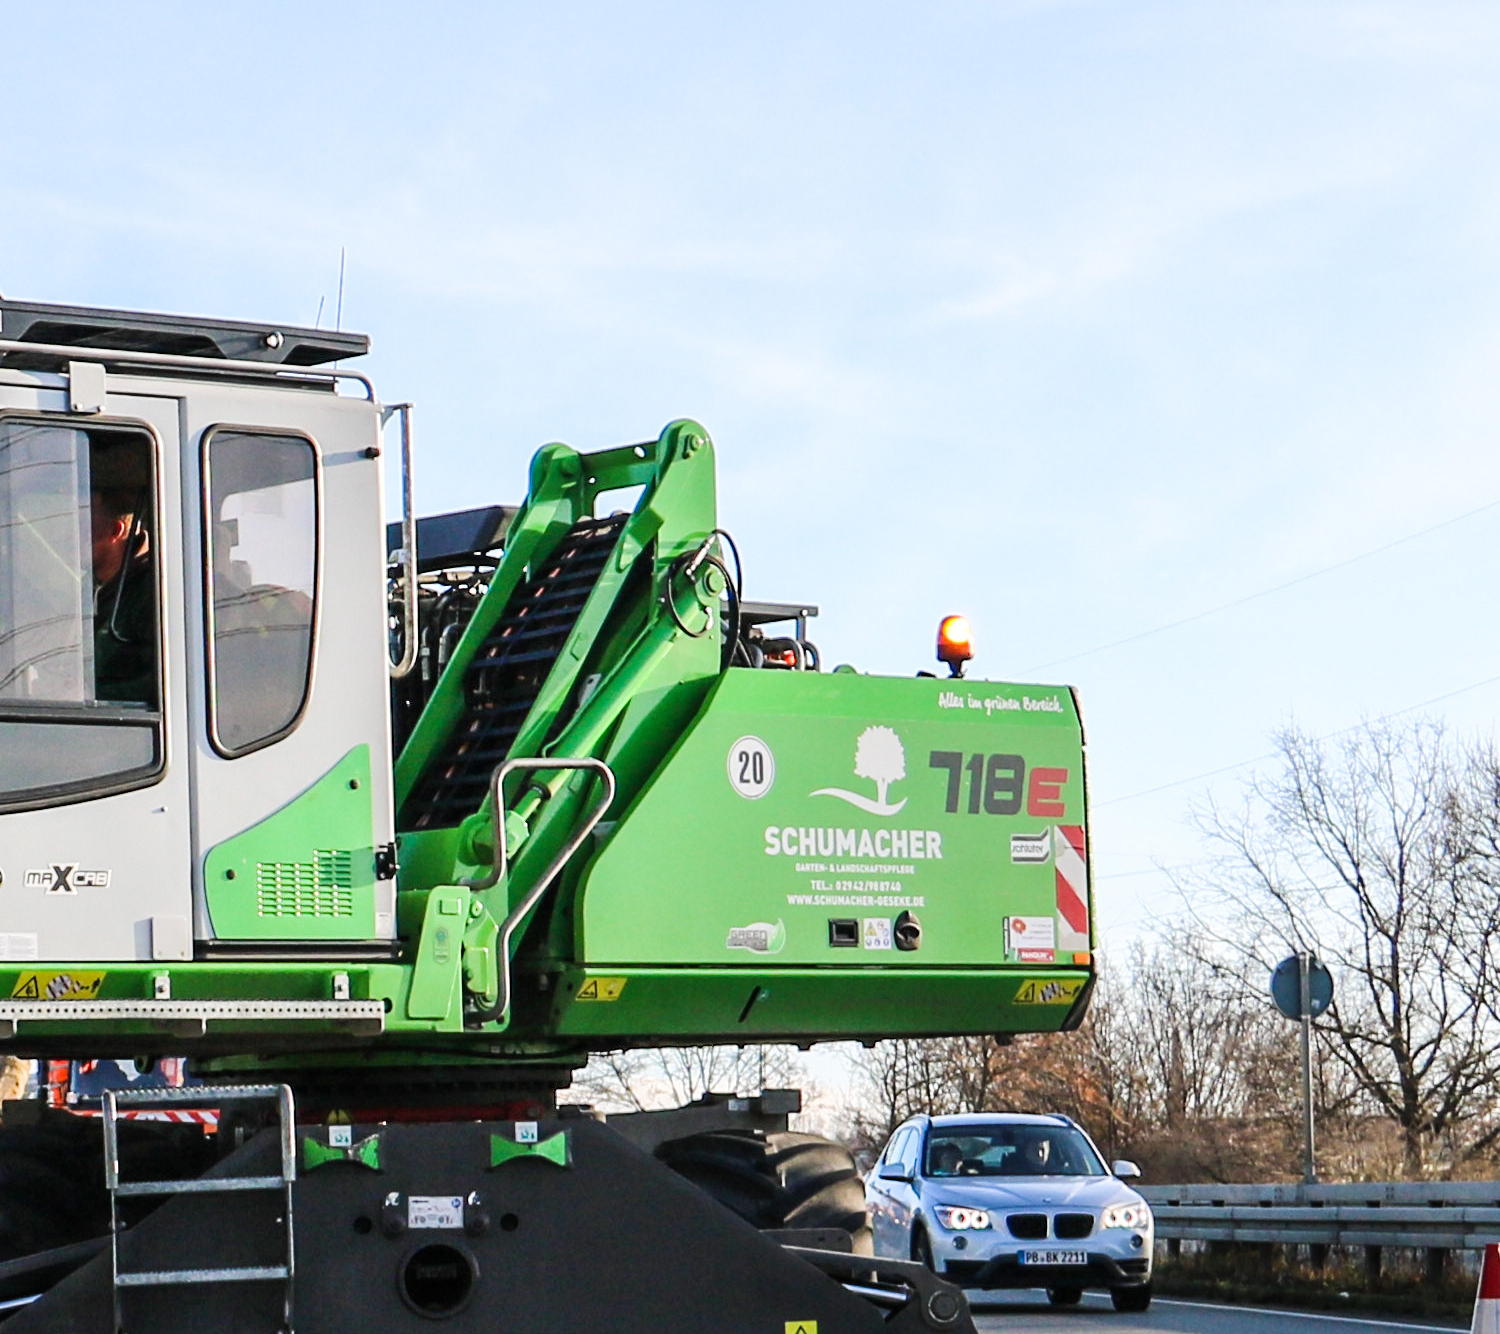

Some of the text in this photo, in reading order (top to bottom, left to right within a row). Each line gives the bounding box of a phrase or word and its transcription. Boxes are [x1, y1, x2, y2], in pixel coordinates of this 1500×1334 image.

[938, 692, 1064, 716] Alles im grünen Bereich.
[739, 751, 764, 784] 20
[929, 750, 1068, 818] 718E
[764, 826, 943, 859] SCHUMACHER
[795, 863, 915, 874] GARTEN- & LANDSCHAFTSPFLEGE
[811, 880, 833, 891] TEL.:
[787, 895, 925, 907] WWW.SCHUMACHER-GESEKE.DE
[1026, 1251, 1085, 1263] PB BK 2211
